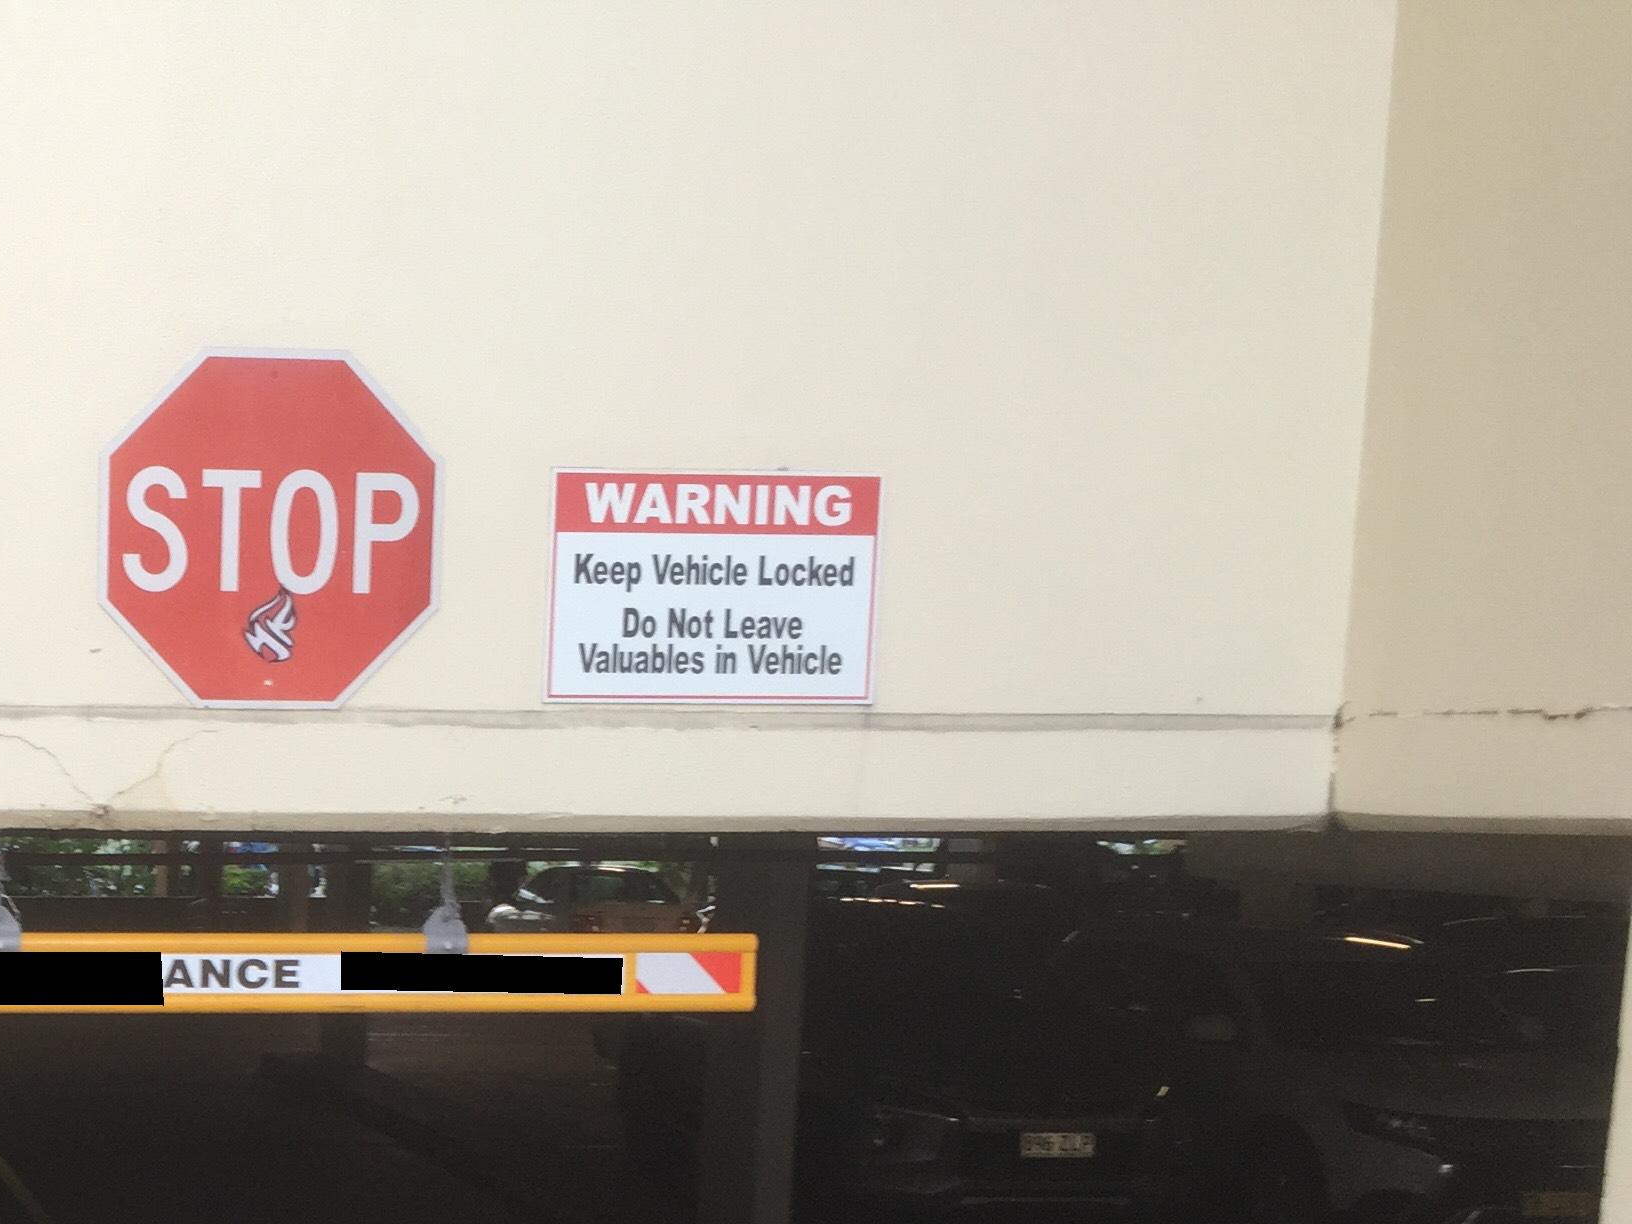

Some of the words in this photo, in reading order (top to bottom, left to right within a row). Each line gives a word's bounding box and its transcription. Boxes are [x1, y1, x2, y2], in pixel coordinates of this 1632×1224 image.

[584, 482, 853, 526] WARNING
[122, 466, 421, 595] STOP
[573, 553, 642, 592] Keep
[652, 554, 747, 585] Vehicle
[758, 555, 855, 586] Locked
[622, 607, 656, 638] Do
[667, 608, 713, 638] Not
[724, 609, 803, 639] Leave
[578, 643, 704, 674] Valuables
[714, 644, 737, 674] in
[747, 644, 842, 675] Vehicle
